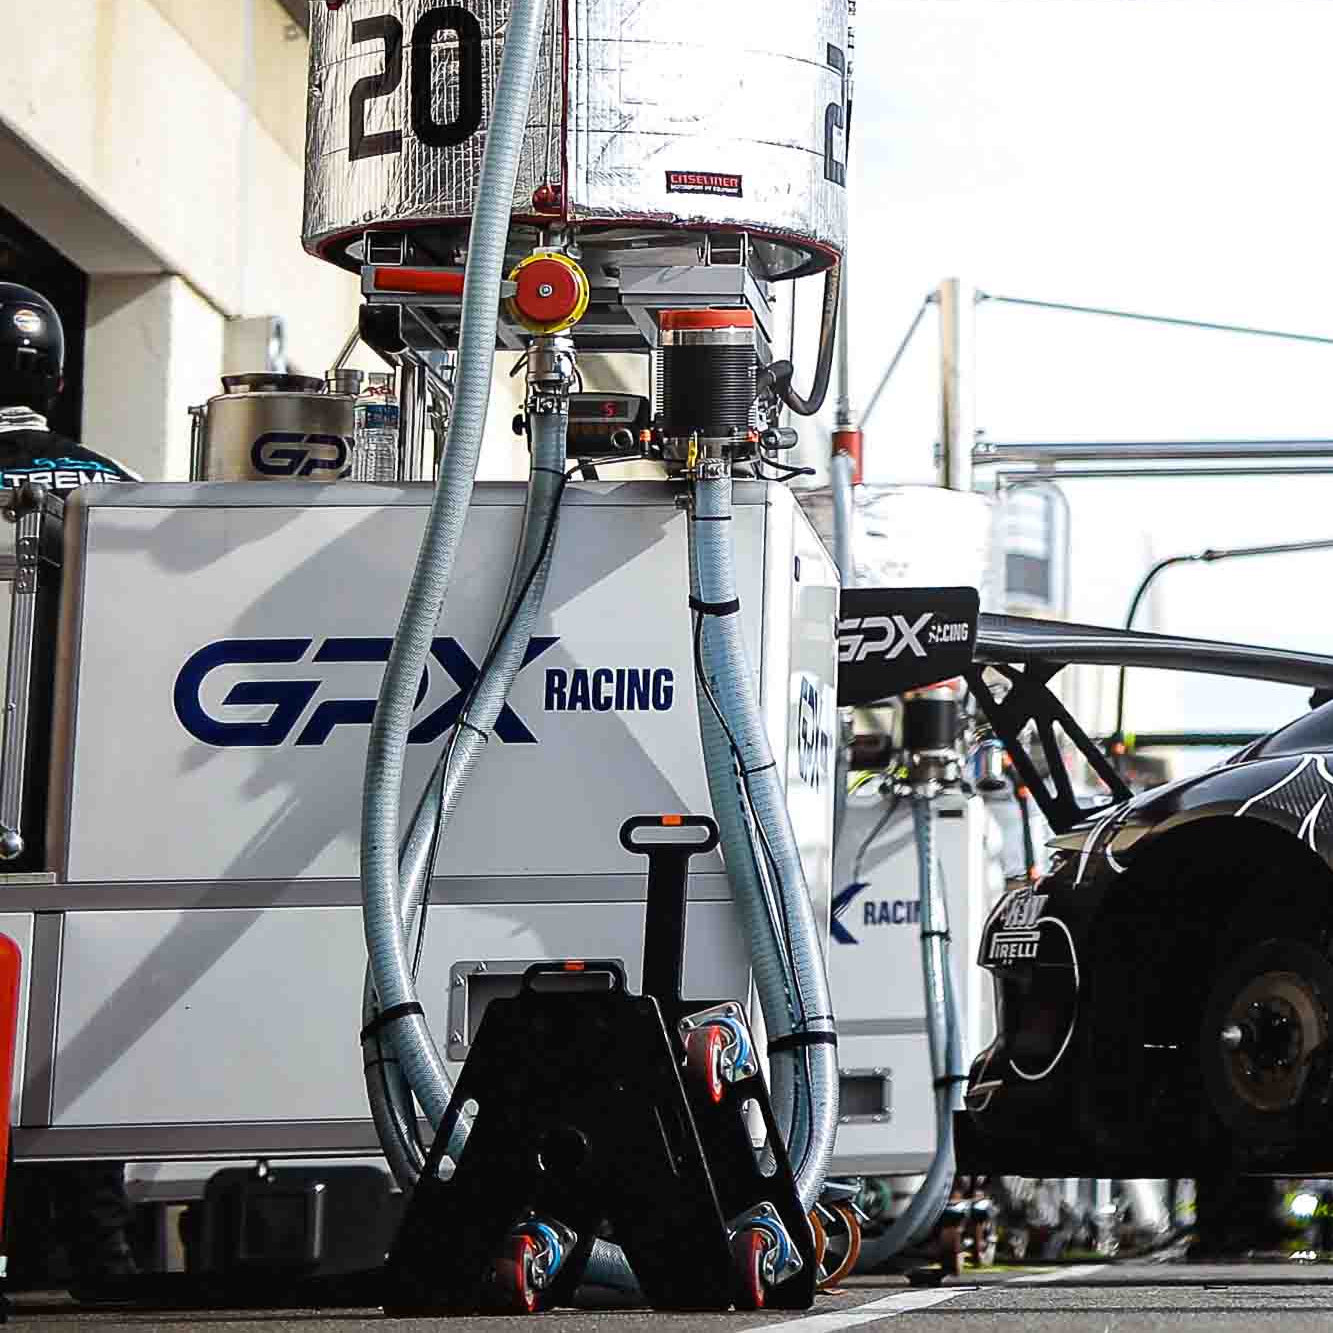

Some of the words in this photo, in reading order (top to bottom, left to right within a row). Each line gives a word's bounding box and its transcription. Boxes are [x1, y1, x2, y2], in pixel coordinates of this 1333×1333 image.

[349, 5, 481, 161] 20
[251, 431, 354, 479] GP
[0, 471, 121, 489] TREME
[173, 635, 561, 748] GPX
[544, 667, 675, 712] RACING
[989, 931, 1041, 959] PIRELLI
